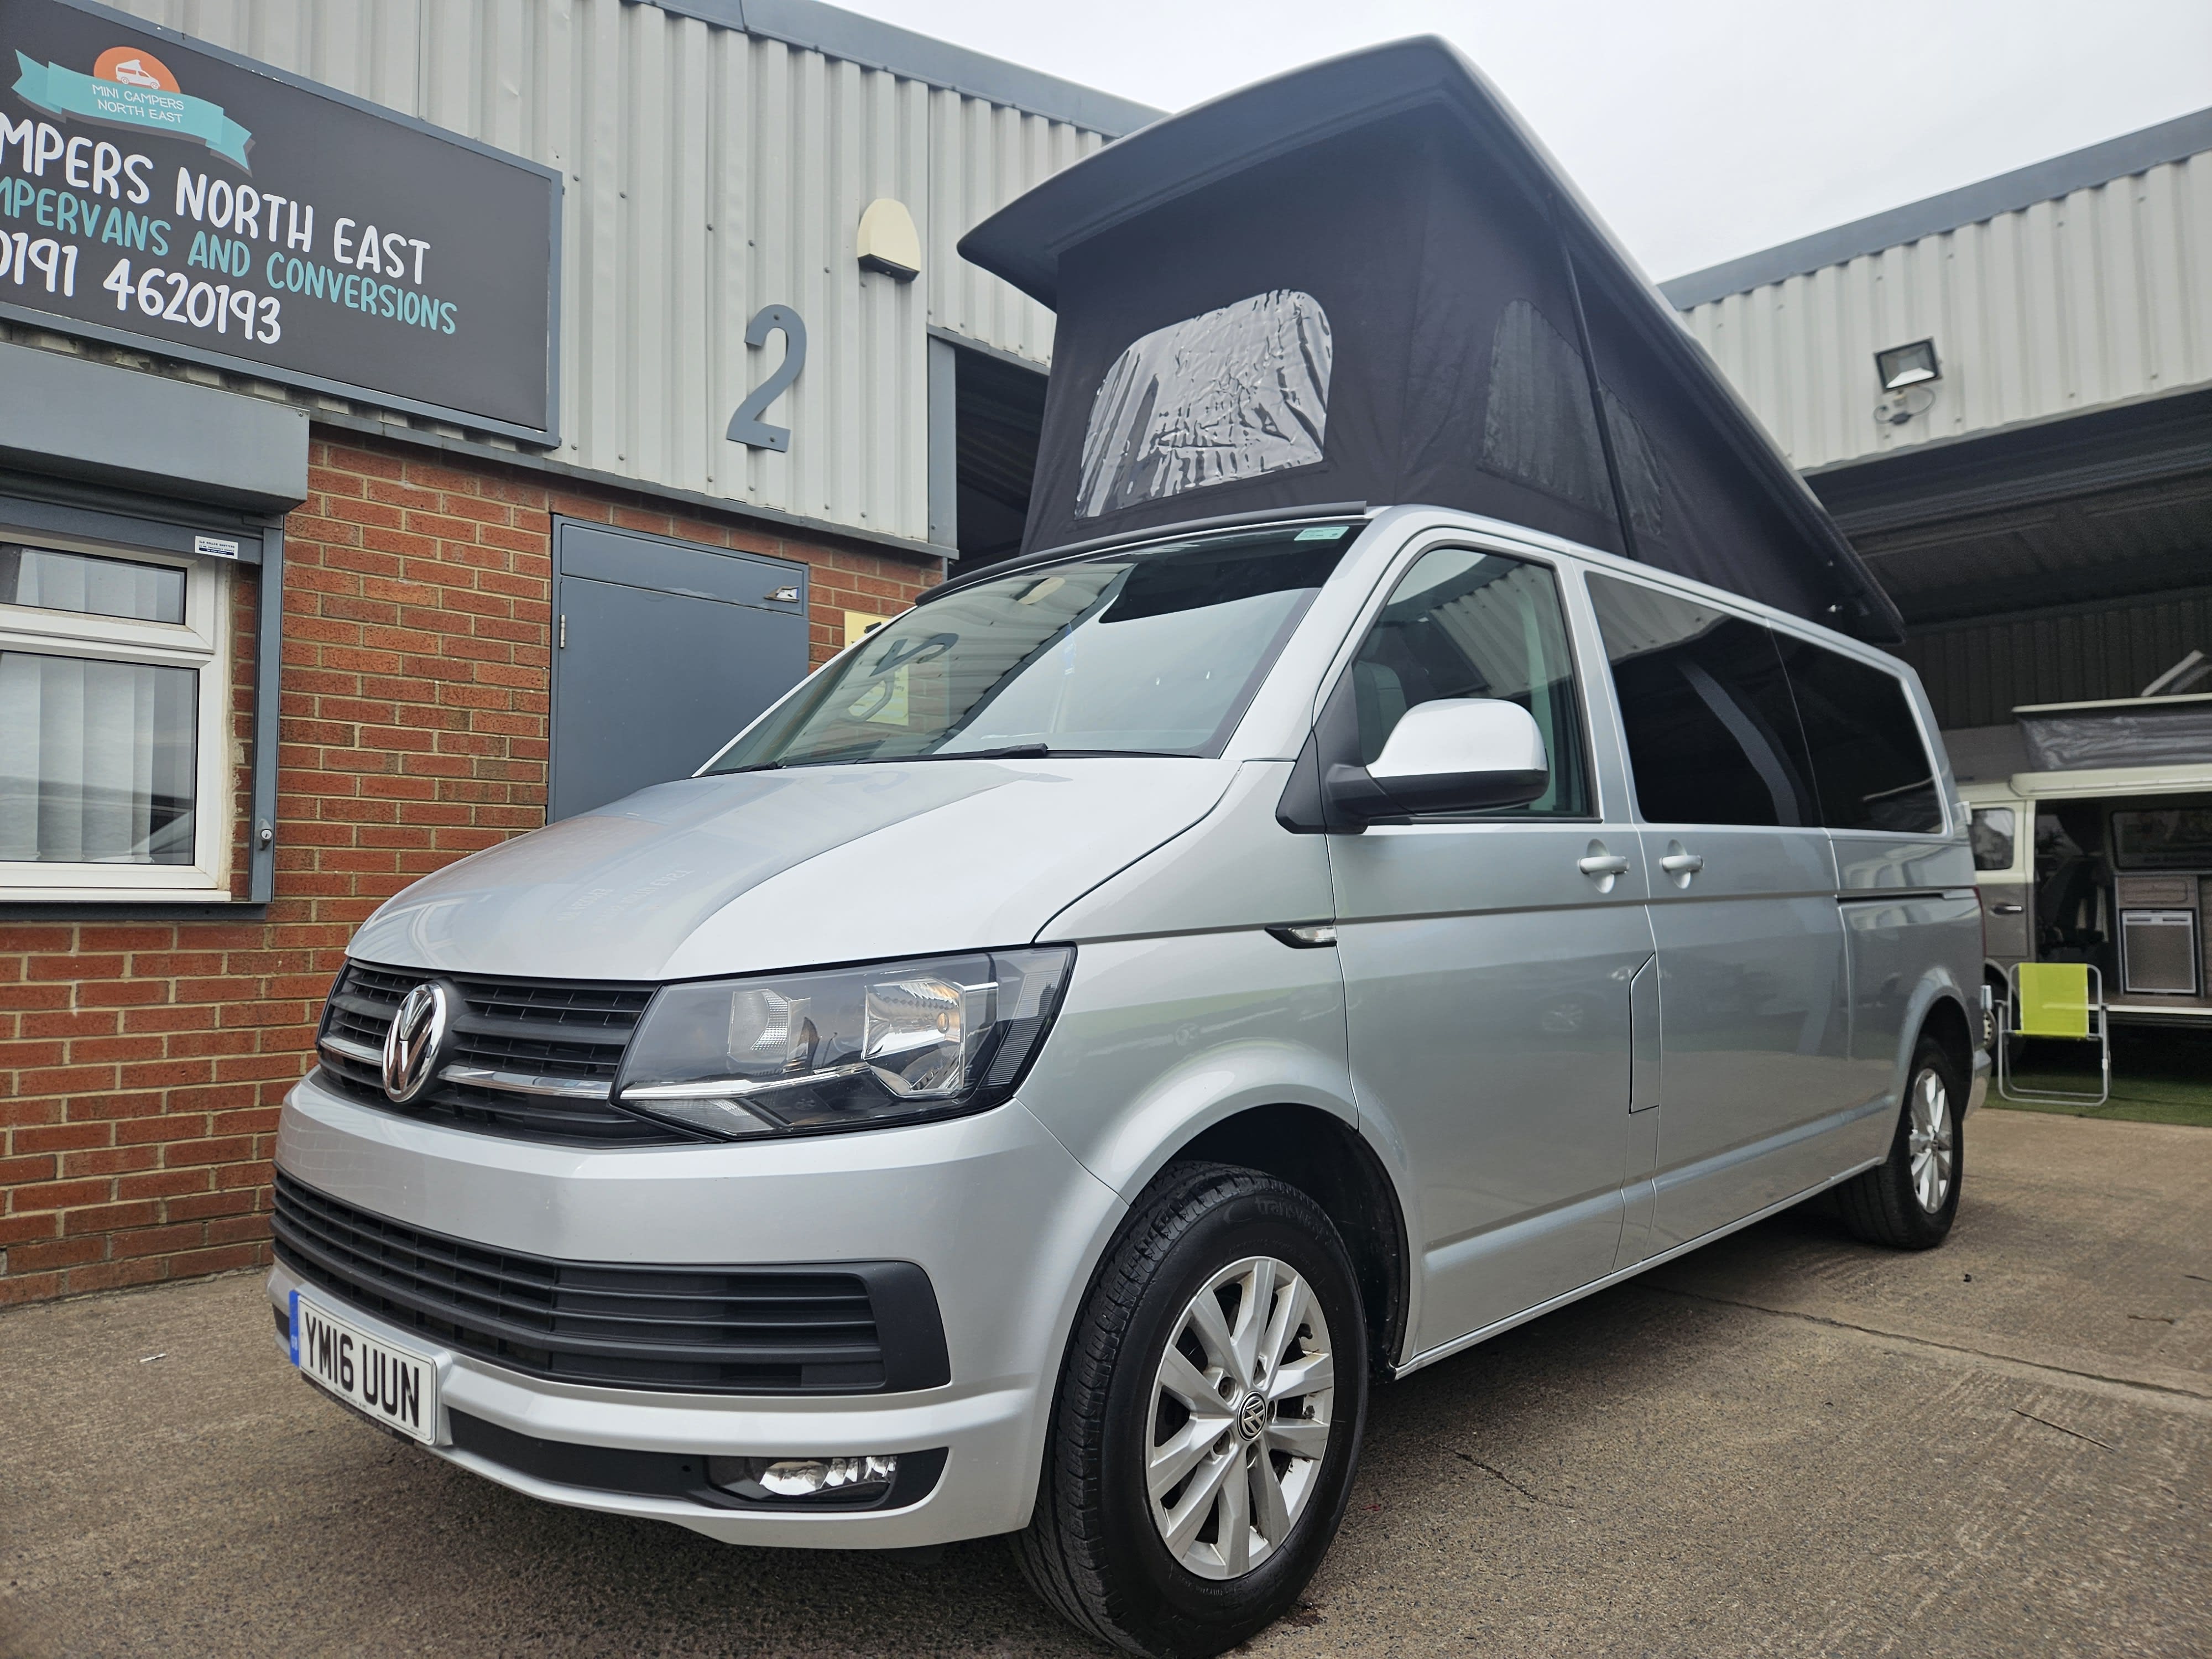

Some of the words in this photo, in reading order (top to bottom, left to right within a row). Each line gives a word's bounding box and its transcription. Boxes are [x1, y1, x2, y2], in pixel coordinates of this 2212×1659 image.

[92, 84, 119, 98] MINI
[124, 90, 184, 110] CAMPERS
[97, 99, 144, 117] NORTH
[149, 109, 182, 123] EAST
[0, 112, 153, 204] MPERS
[176, 166, 313, 252] NORTH
[333, 217, 431, 284] EAST
[103, 258, 281, 344] 4620193
[187, 231, 251, 276] AND
[267, 252, 457, 335] CONVERSIONS
[726, 304, 807, 452] 2
[305, 1311, 354, 1393] YM16
[362, 1344, 419, 1428] UUN
